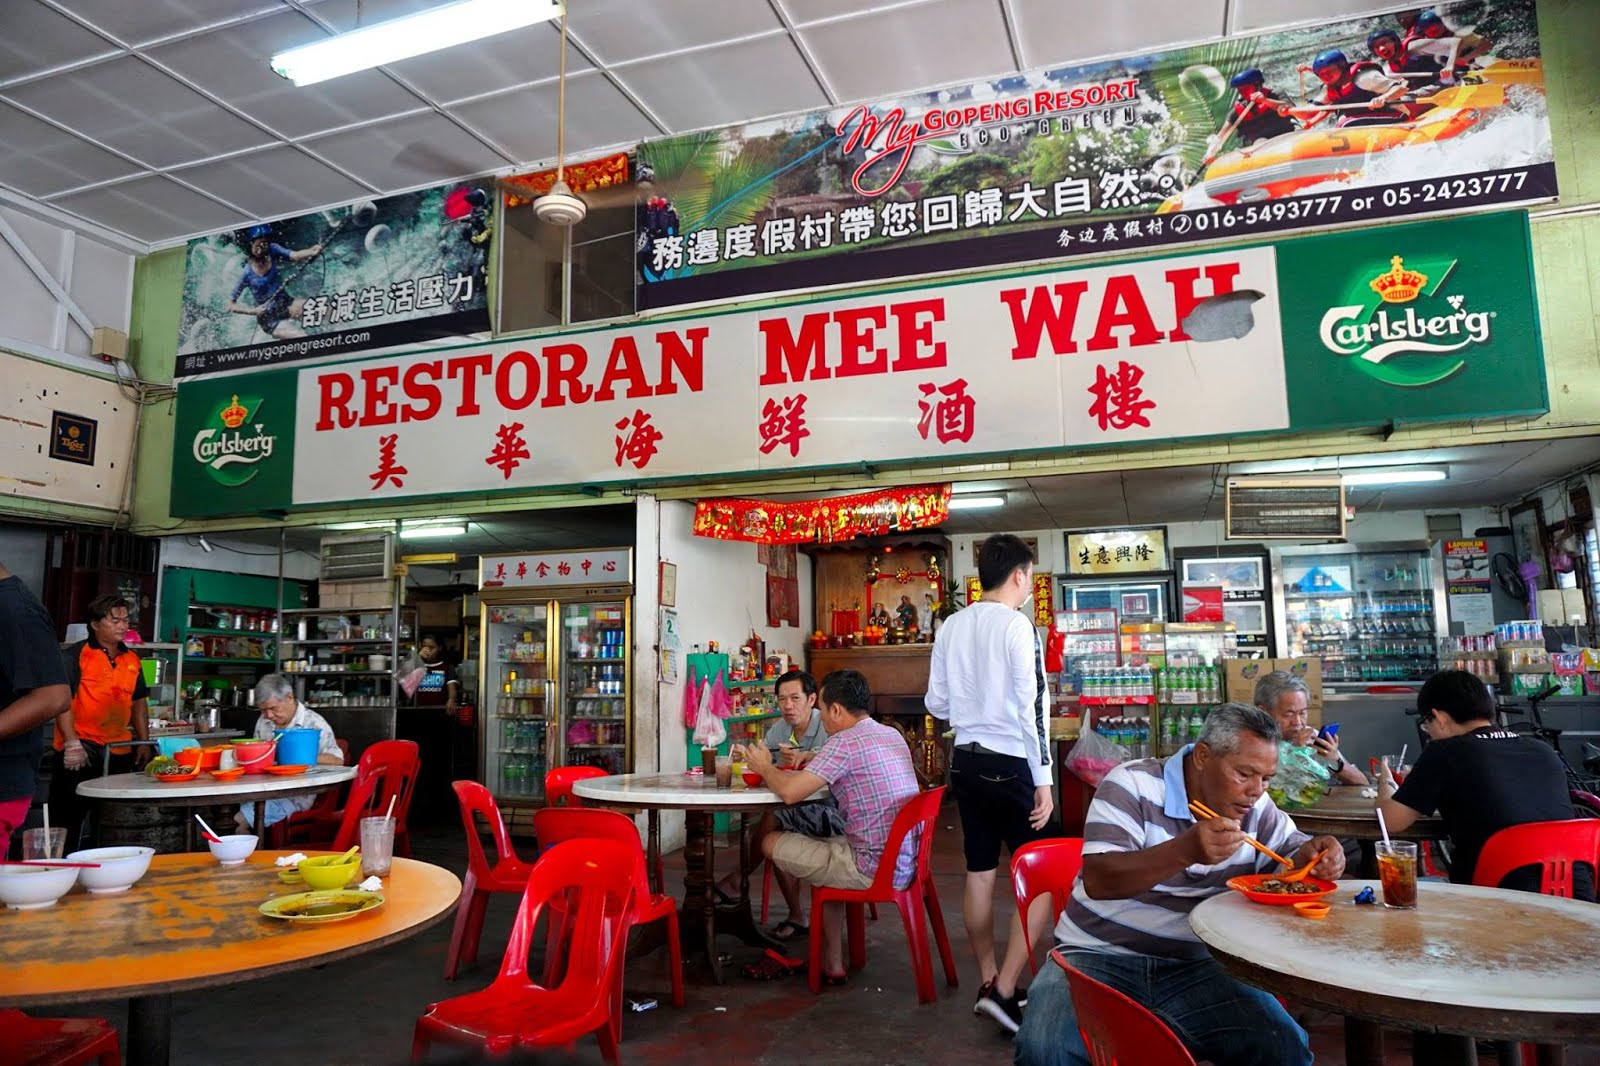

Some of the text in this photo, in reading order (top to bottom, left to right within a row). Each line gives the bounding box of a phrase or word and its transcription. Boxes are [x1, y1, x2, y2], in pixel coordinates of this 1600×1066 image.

[836, 104, 920, 197] My
[1195, 195, 1343, 231] 016-5493777
[1351, 196, 1375, 211] or
[1382, 171, 1529, 208] 05-2423777
[301, 272, 474, 328] 舒減生活壓力
[317, 262, 1241, 432] RESTORAN MEE WAH
[1320, 298, 1492, 363] Carlsberg
[193, 425, 274, 468] Carlsberg
[494, 559, 617, 580] 美華食物中心
